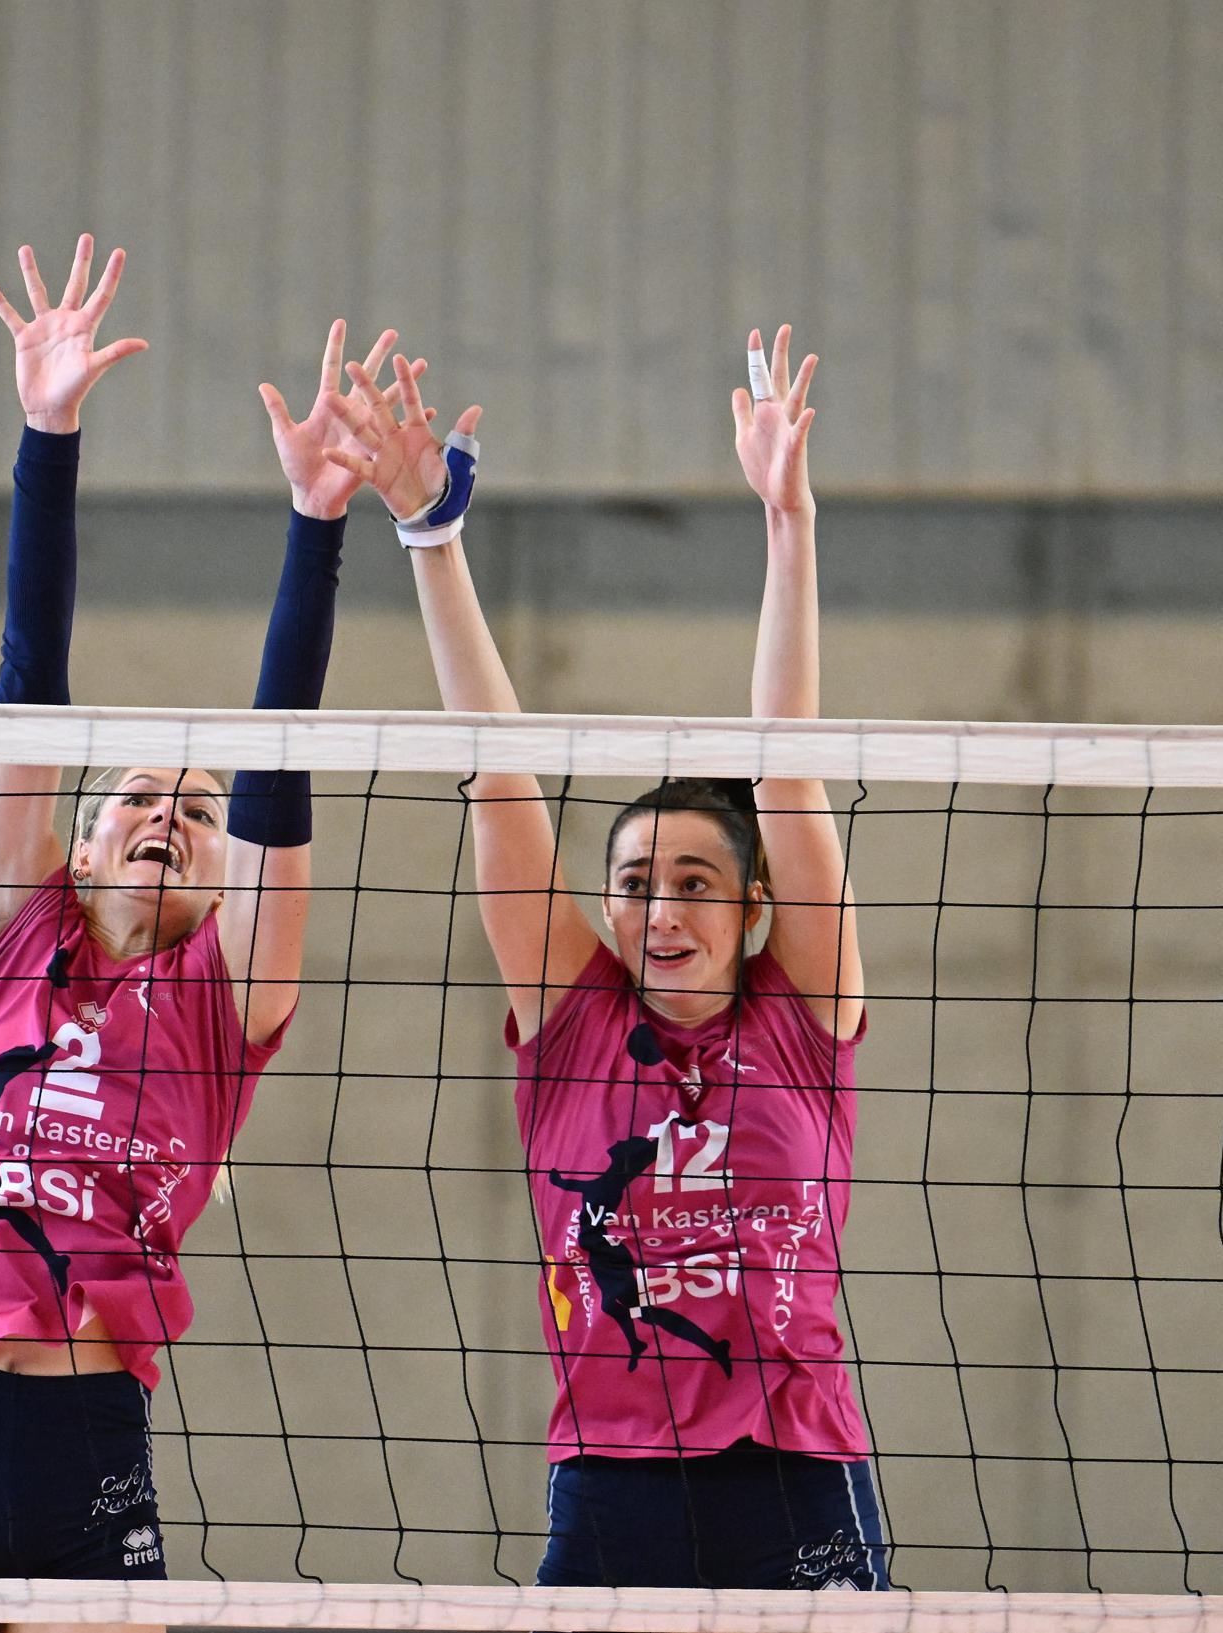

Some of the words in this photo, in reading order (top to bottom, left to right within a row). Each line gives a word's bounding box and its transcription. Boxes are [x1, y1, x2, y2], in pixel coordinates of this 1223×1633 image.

[45, 1022, 102, 1095] 2
[23, 1110, 160, 1163] Kasteren
[647, 1110, 734, 1194] 12
[585, 1202, 640, 1228] Van
